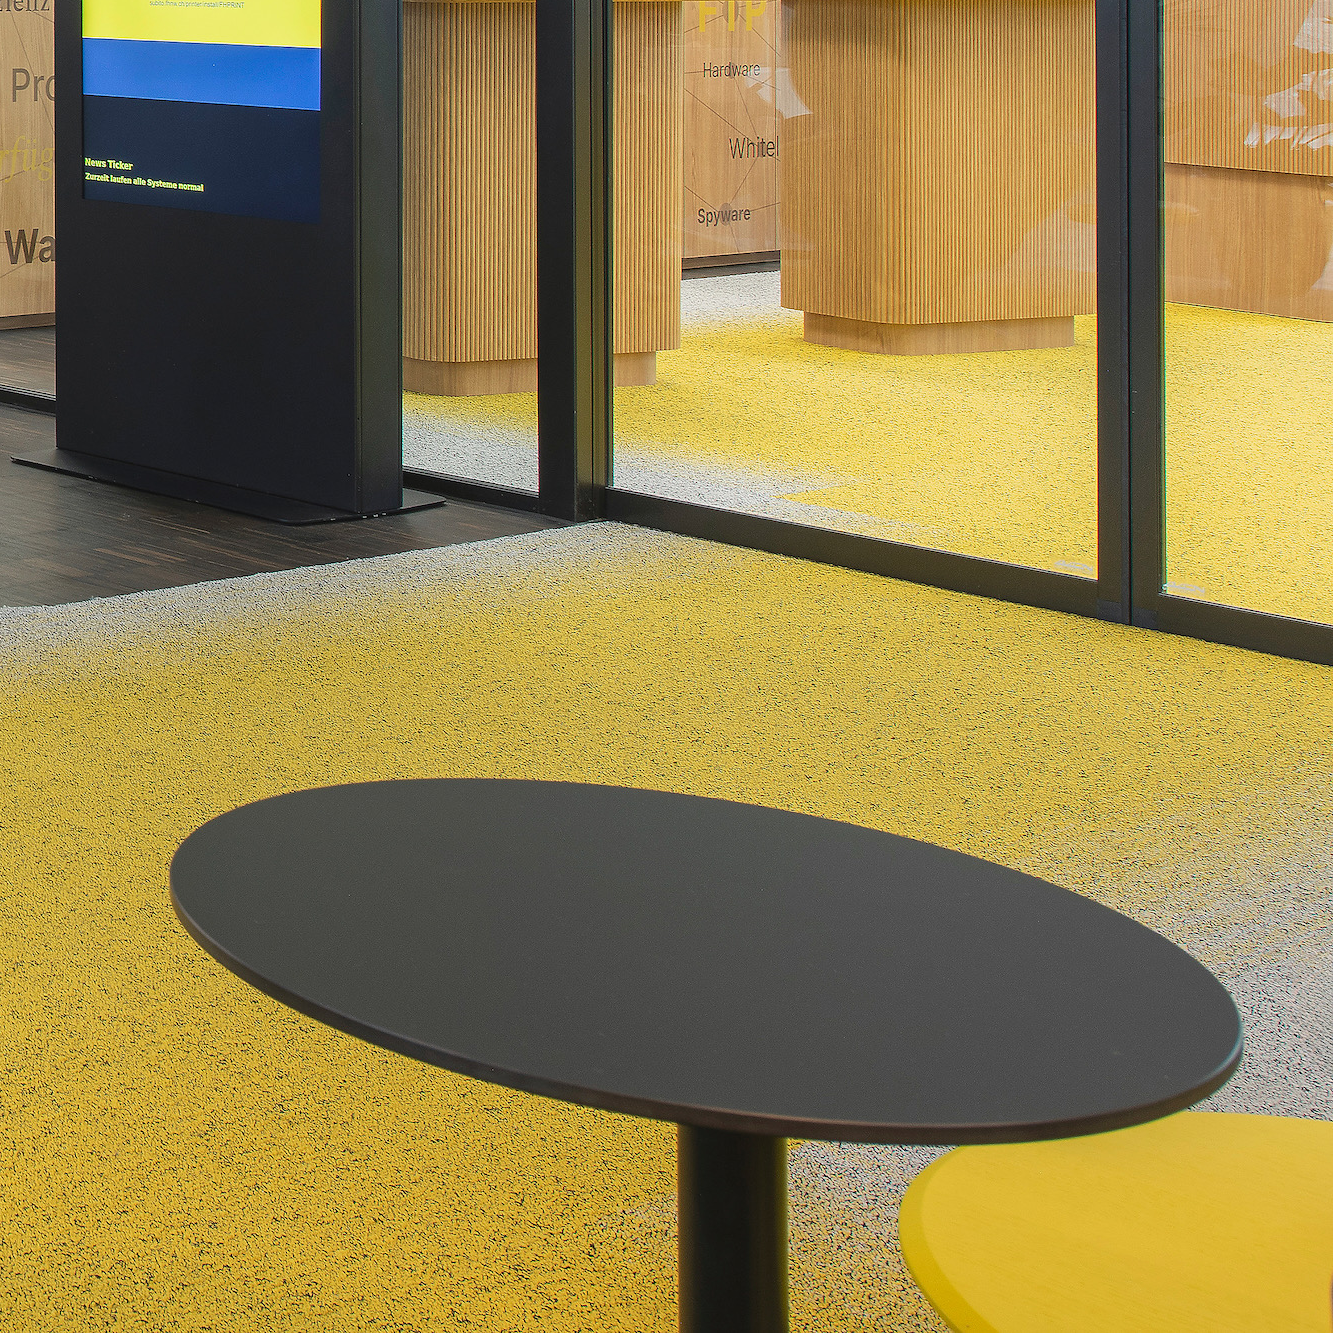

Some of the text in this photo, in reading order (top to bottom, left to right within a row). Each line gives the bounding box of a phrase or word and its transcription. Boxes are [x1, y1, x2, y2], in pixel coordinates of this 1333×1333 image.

[703, 62, 761, 78] Hardware
[84, 157, 133, 170] News Ticker
[85, 172, 205, 192] Zurzeit laufen alle Systeme normal
[697, 207, 751, 227] Spyware
